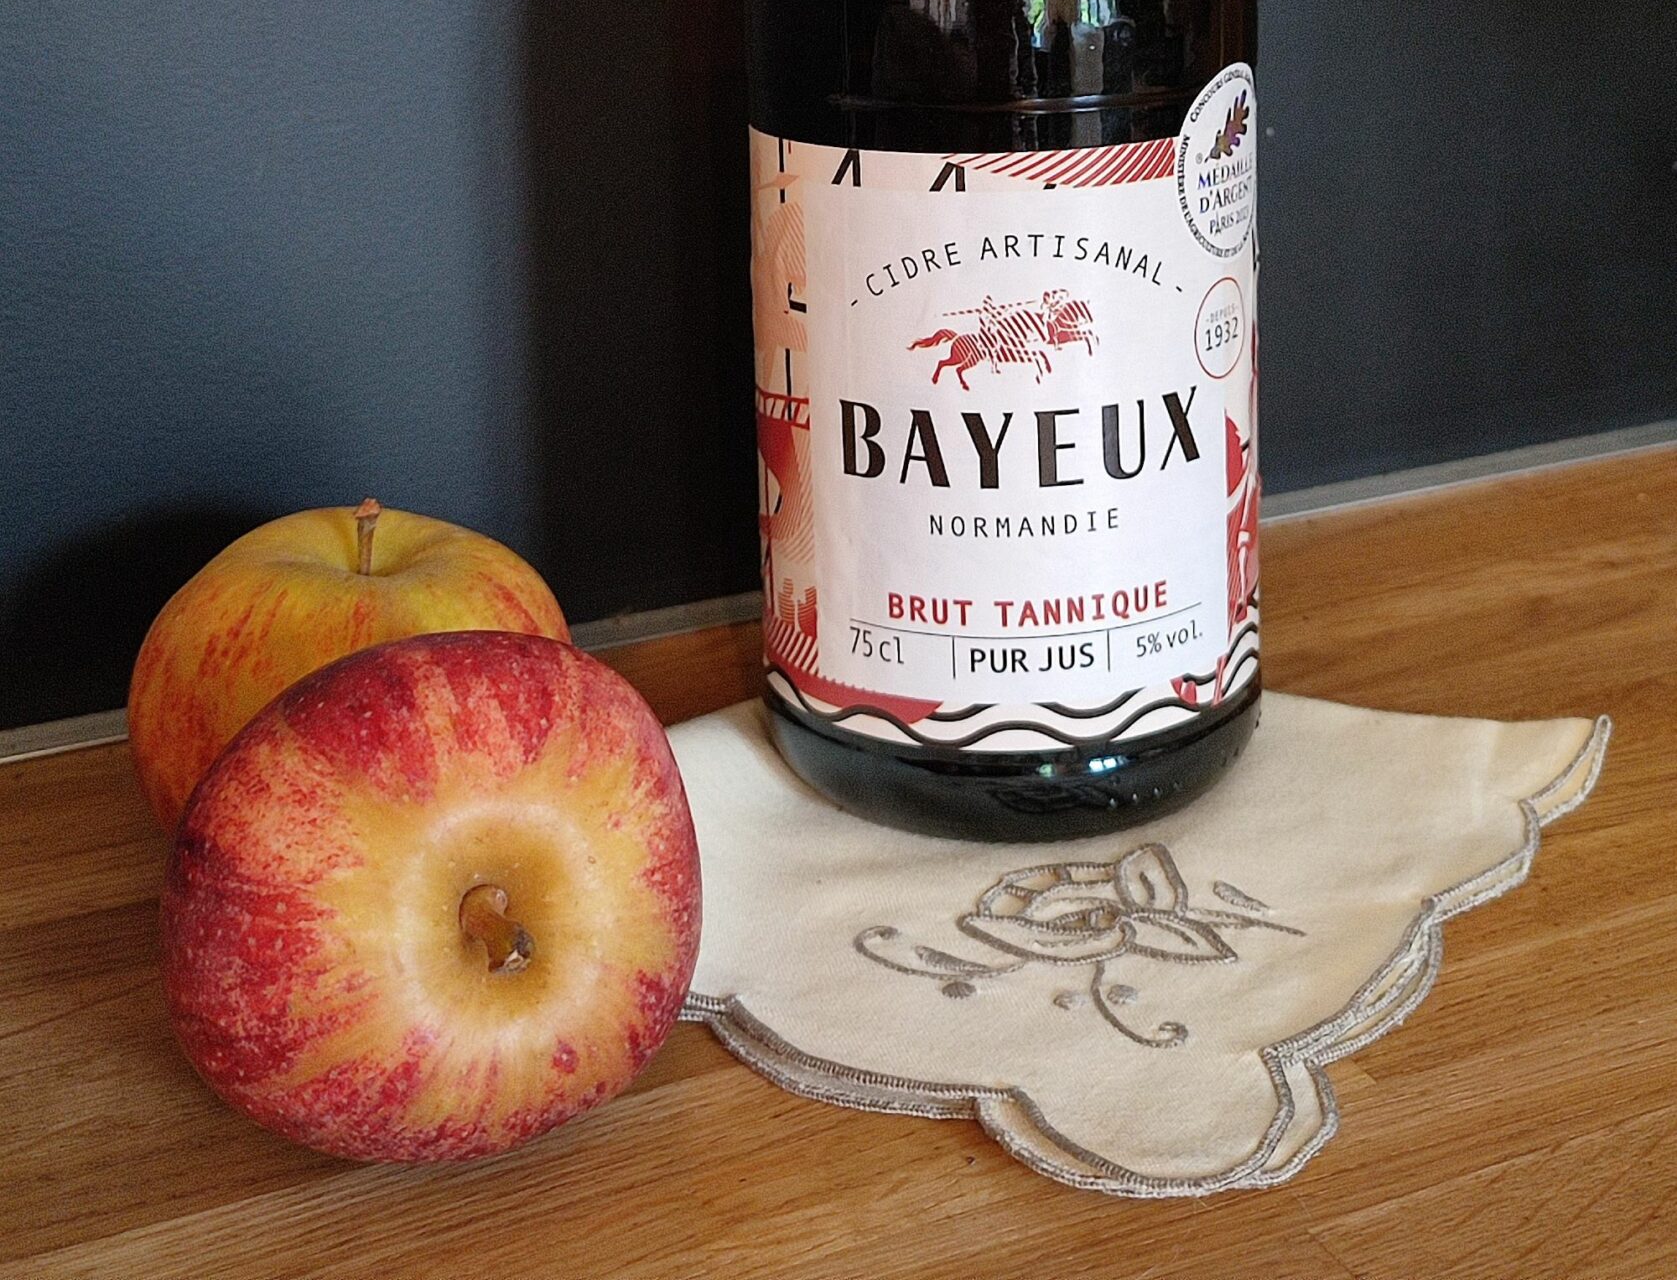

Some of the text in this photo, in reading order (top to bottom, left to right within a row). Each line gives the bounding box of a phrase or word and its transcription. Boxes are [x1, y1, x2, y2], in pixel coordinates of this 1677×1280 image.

[865, 233, 1163, 297] CIDRE ARTISANAL
[1205, 316, 1239, 352] 1932
[838, 384, 1201, 490] BAYEUX
[929, 507, 1120, 539] NORMANDIE
[887, 579, 1169, 628] BRUT TANNIQUE
[969, 641, 1095, 674] PUR JUS
[1136, 619, 1203, 658] 5% vol.
